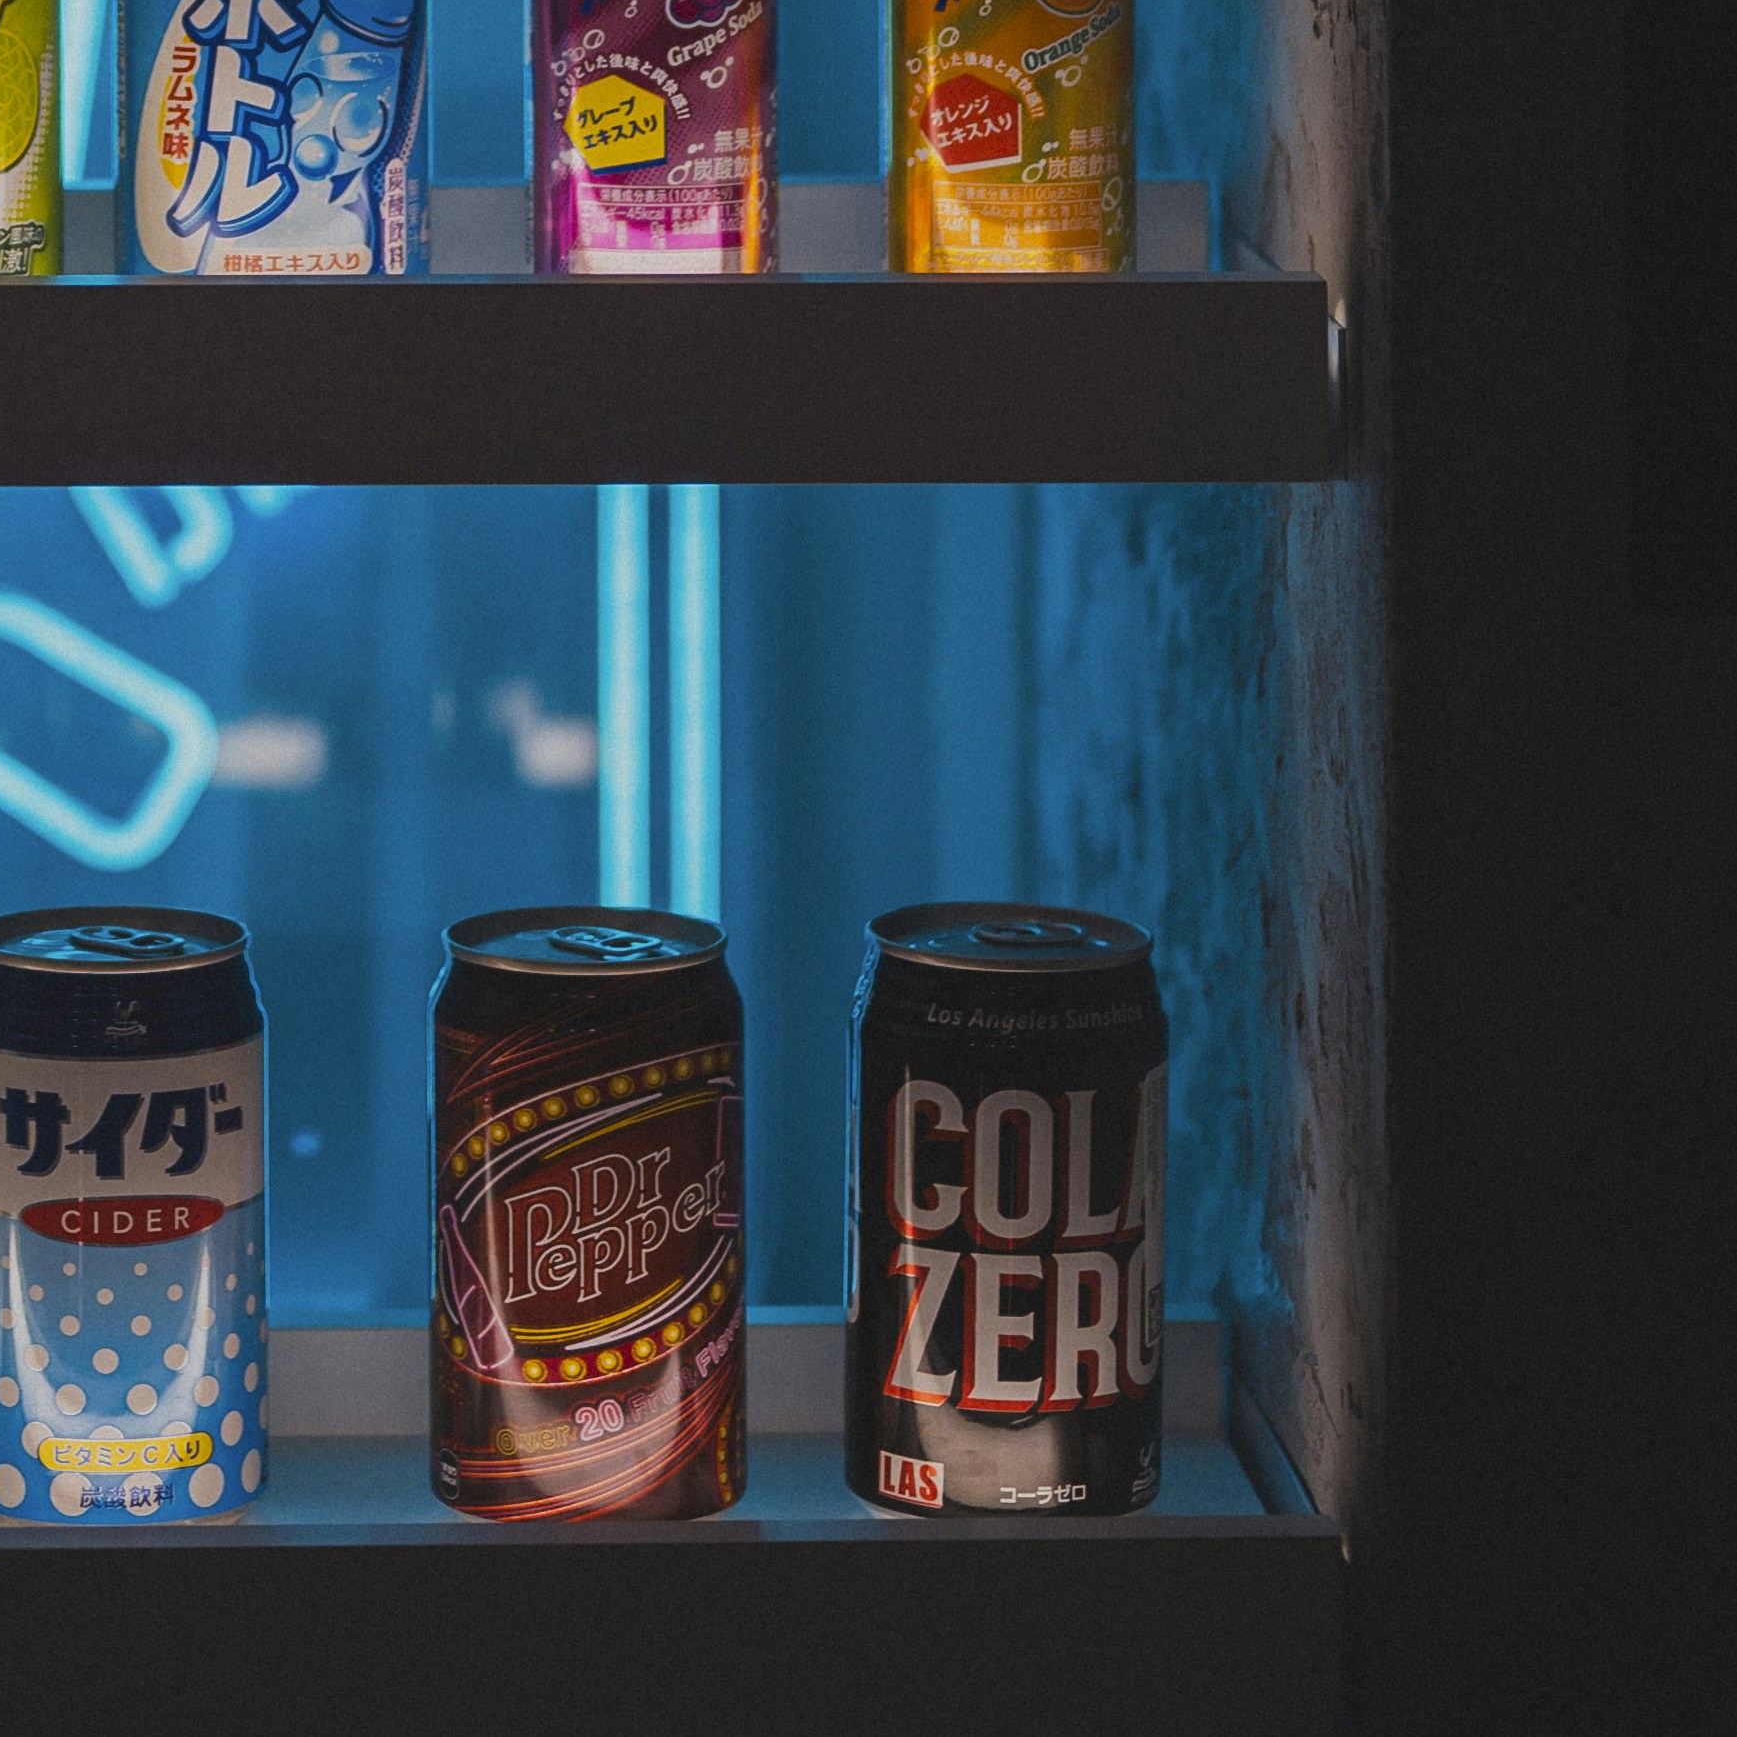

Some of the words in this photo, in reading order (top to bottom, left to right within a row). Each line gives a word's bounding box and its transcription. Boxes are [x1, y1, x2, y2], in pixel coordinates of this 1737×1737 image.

[666, 26, 727, 67] Grape
[728, 0, 764, 36] Soda
[1023, 29, 1091, 73] Orange
[162, 45, 198, 159] ラムネ味
[576, 96, 636, 129] グレープ
[929, 95, 990, 127] オレンジ
[583, 114, 658, 150] エキス入り
[936, 112, 1014, 149] エキス入り
[222, 252, 361, 273] 柑橘エキス入り
[926, 1002, 962, 1025] Los
[967, 1007, 1059, 1035] Angeles
[571, 1146, 671, 1235] Dr
[61, 1206, 190, 1235] CIDER
[504, 1159, 726, 1304] Pepper
[890, 1243, 1161, 1402] ZERO
[495, 1423, 571, 1456] Over
[575, 1398, 624, 1442] 20
[79, 1482, 175, 1509] 炭酸飲料
[883, 1454, 939, 1502] LAS
[999, 1484, 1087, 1505] コーラゼロ
